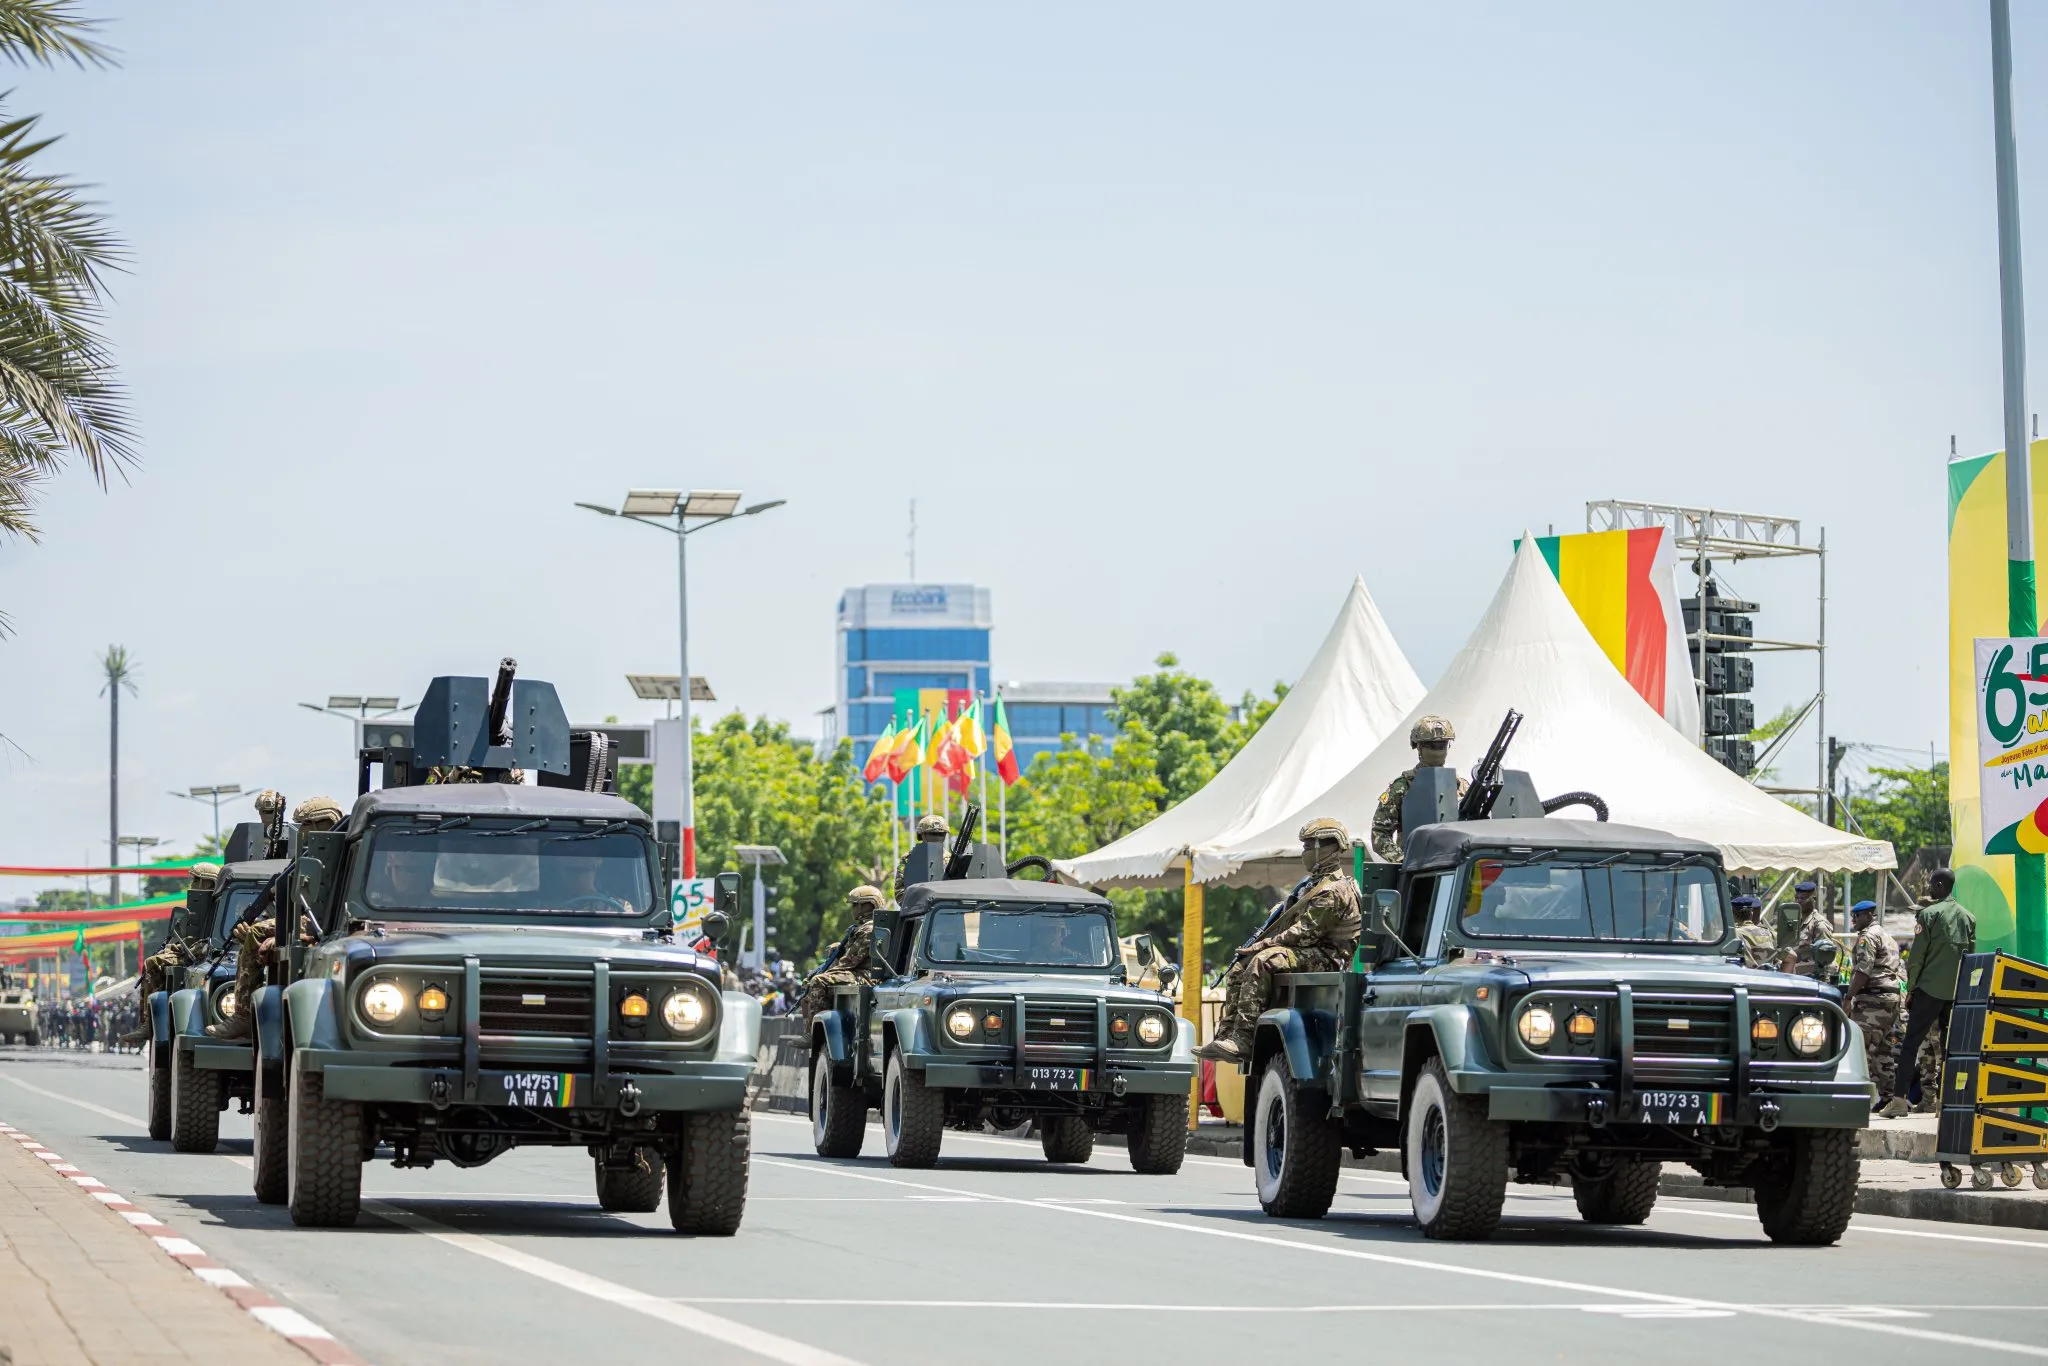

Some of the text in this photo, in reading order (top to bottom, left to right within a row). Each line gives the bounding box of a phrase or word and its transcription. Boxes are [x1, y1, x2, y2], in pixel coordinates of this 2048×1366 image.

[1986, 643, 2048, 743] 65
[2001, 752, 2021, 764] Joyeuse
[671, 884, 704, 921] 65
[504, 1073, 558, 1091] 014751
[1642, 1092, 1700, 1108] 013733
